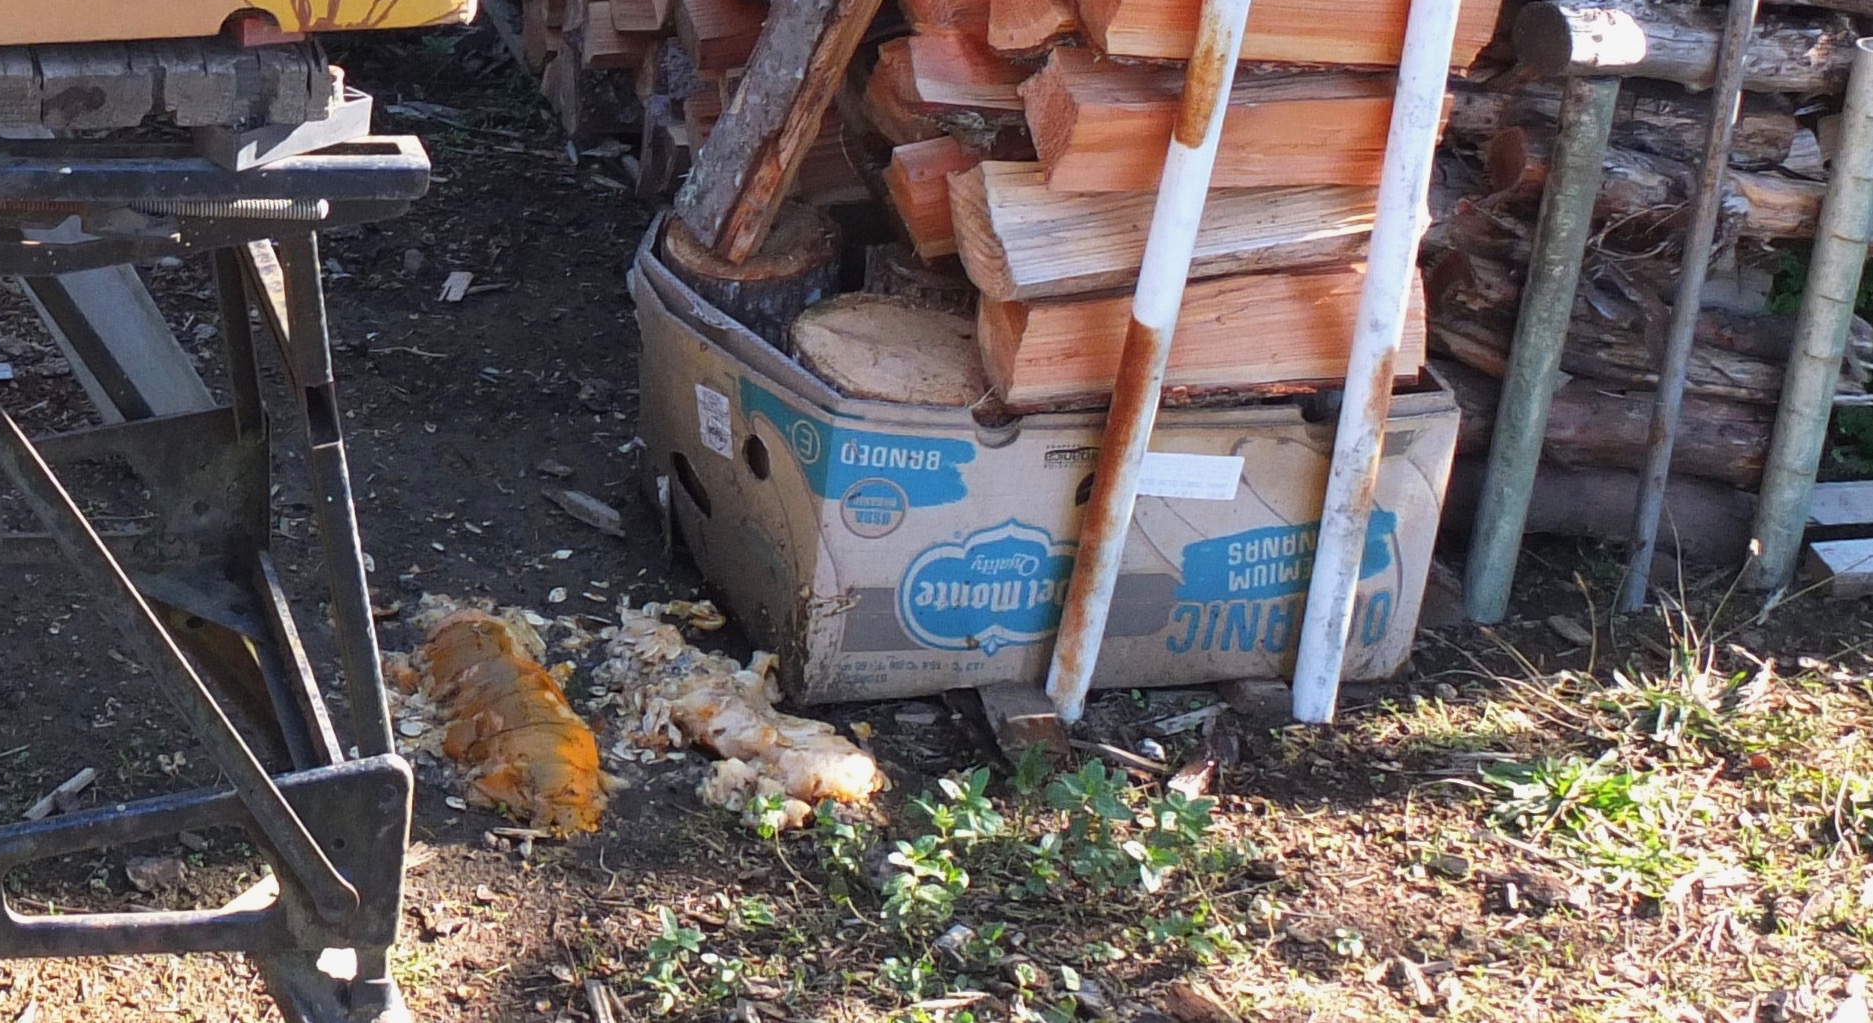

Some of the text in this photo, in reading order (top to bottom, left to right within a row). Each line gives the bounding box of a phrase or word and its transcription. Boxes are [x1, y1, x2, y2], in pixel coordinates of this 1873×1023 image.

[840, 442, 941, 471] BANDED
[1228, 531, 1317, 565] NANAS
[971, 553, 1039, 577] Quality
[1228, 558, 1313, 592] EMIUM
[915, 581, 1021, 612] Monte
[1166, 591, 1392, 655] OANIC
